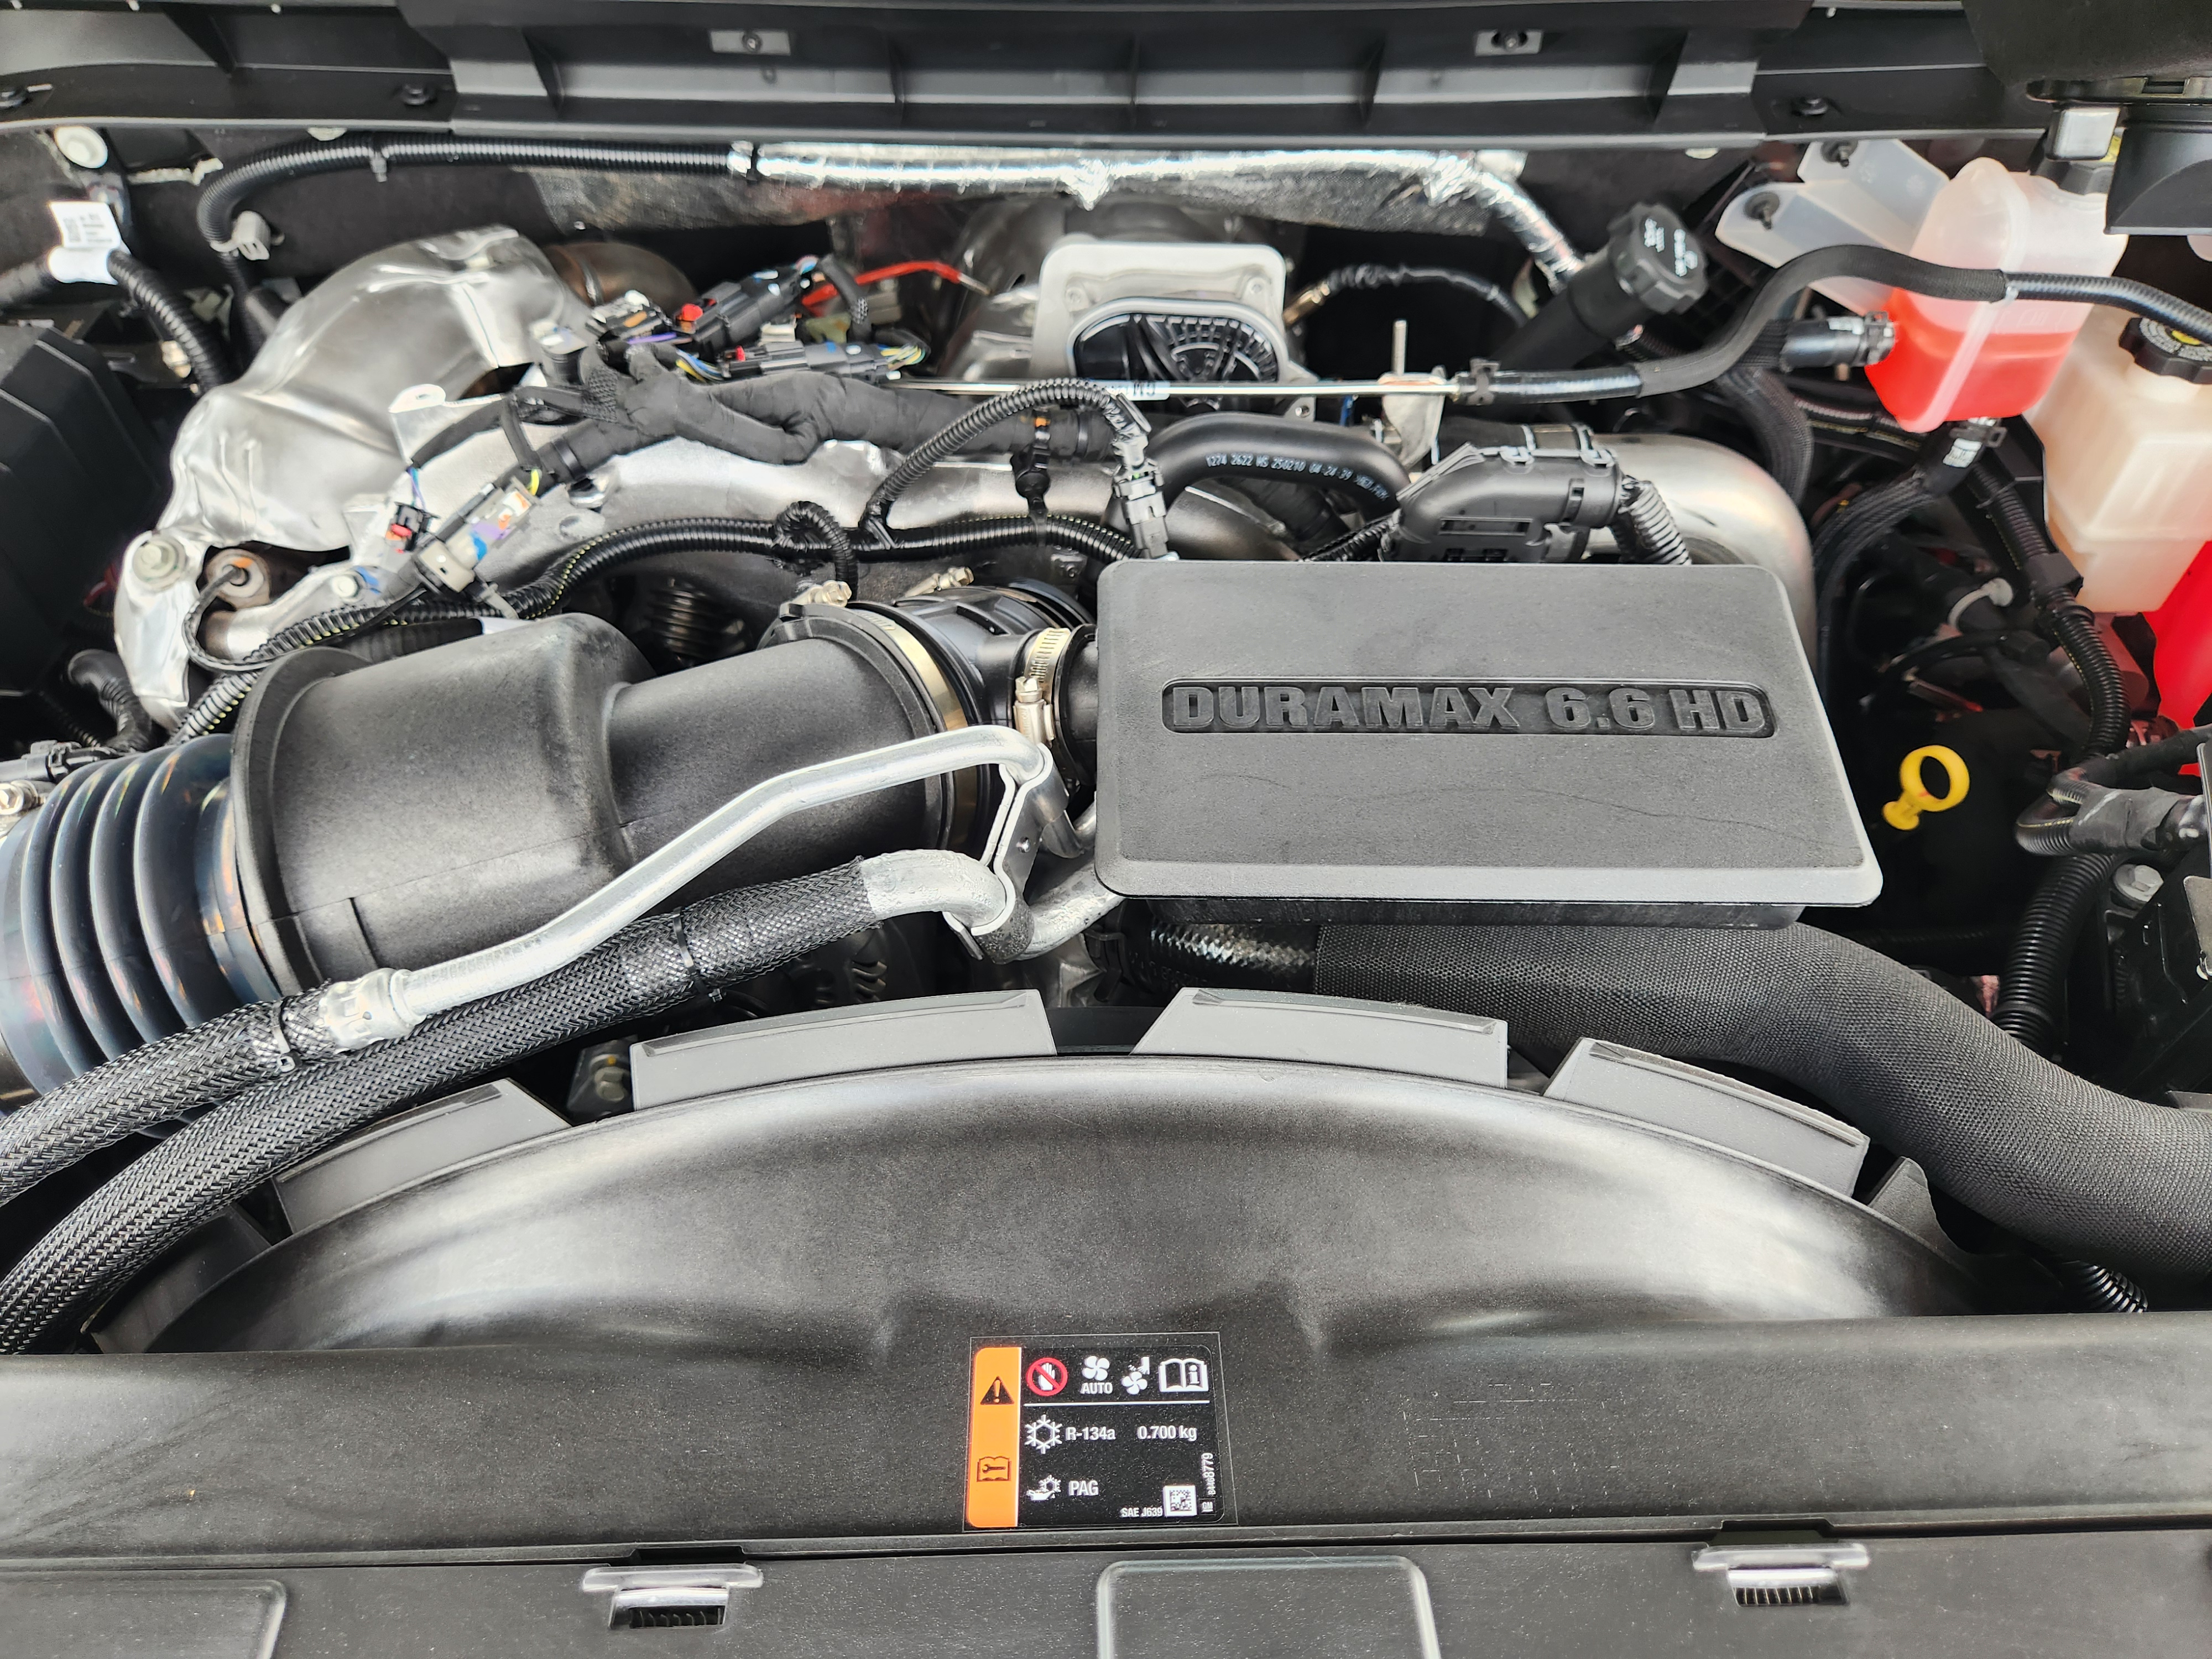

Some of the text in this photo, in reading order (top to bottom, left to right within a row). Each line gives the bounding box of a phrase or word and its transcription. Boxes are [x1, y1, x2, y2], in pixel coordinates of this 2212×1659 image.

[1173, 687, 1766, 732] DURAMAX 6.6 HD
[1080, 1382, 1113, 1395] AUTO
[1066, 1425, 1198, 1442] R-134a 0.700 kg
[1200, 1452, 1217, 1495] 84468779
[1068, 1480, 1099, 1496] PAG
[1120, 1507, 1163, 1518] SAE J639
[1201, 1501, 1214, 1510] GM
